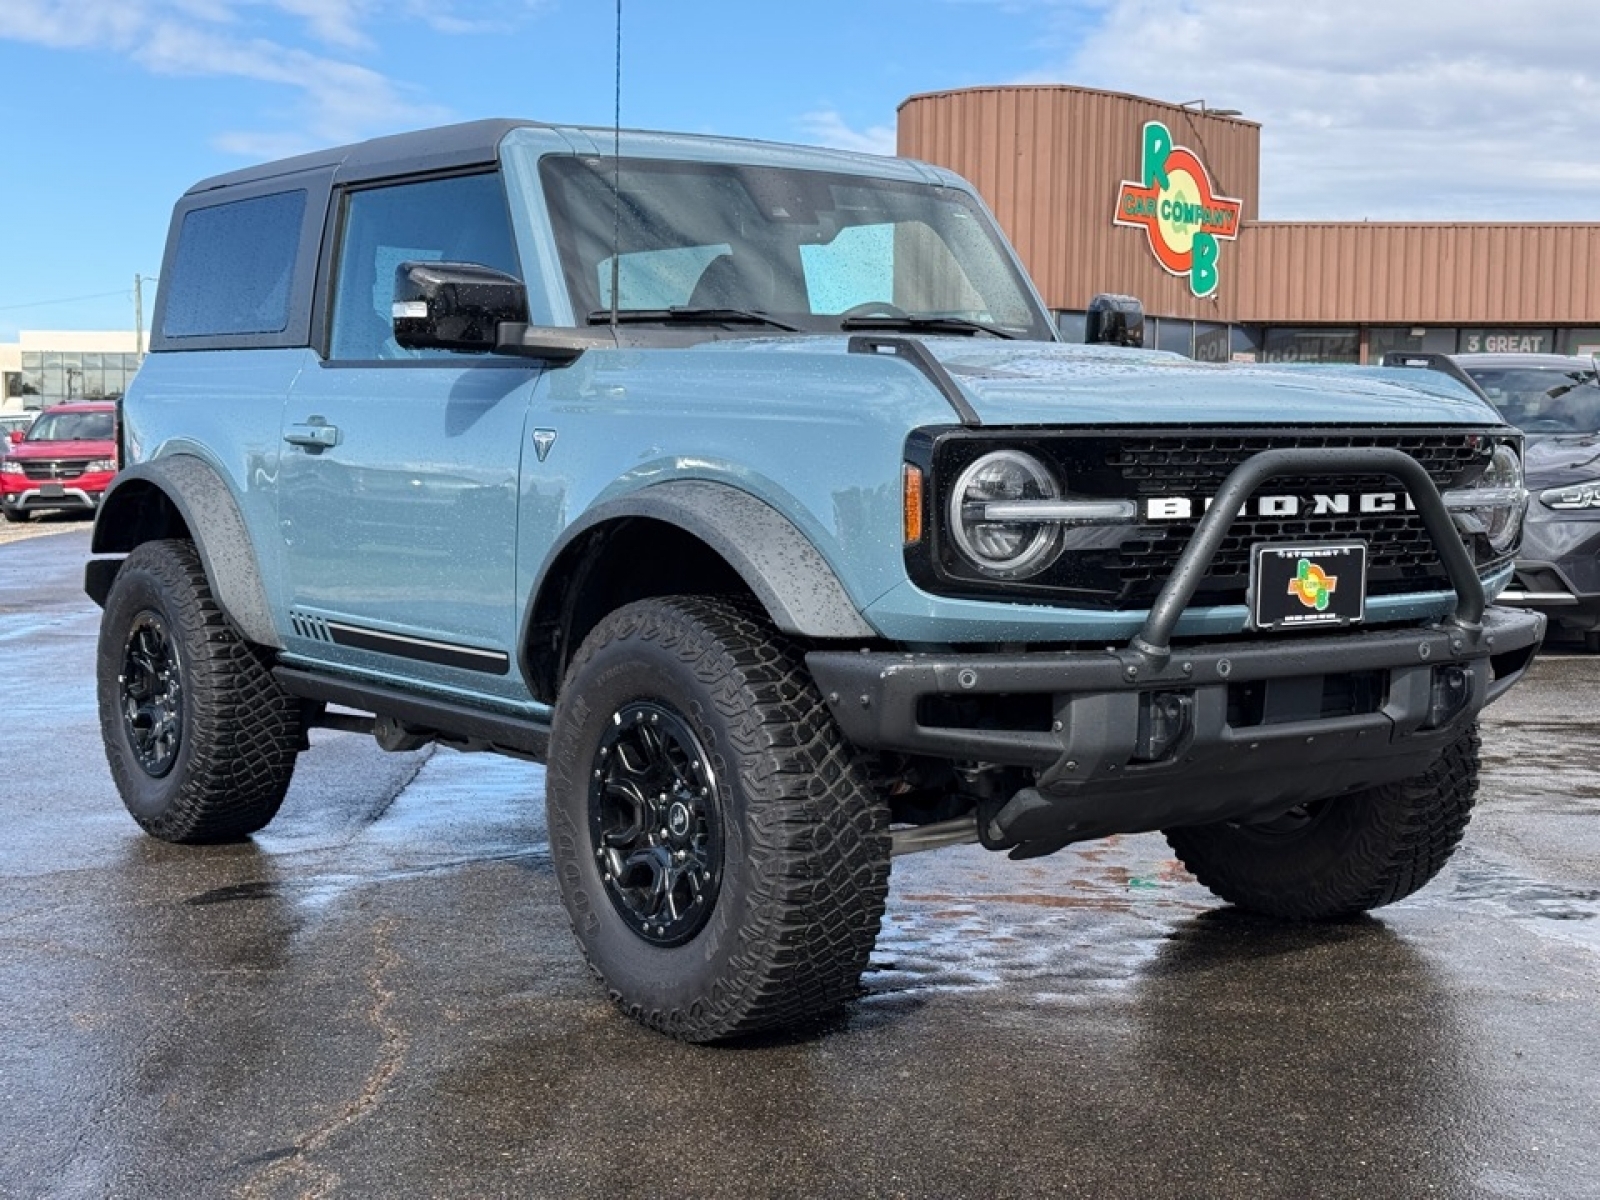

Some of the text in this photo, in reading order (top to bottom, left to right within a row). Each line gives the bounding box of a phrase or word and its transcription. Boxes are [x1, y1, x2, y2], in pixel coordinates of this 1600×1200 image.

[1143, 122, 1172, 191] R
[1122, 193, 1236, 229] CAR COMPANY
[1191, 231, 1219, 296] B
[1468, 335, 1543, 353] 3 GREAT
